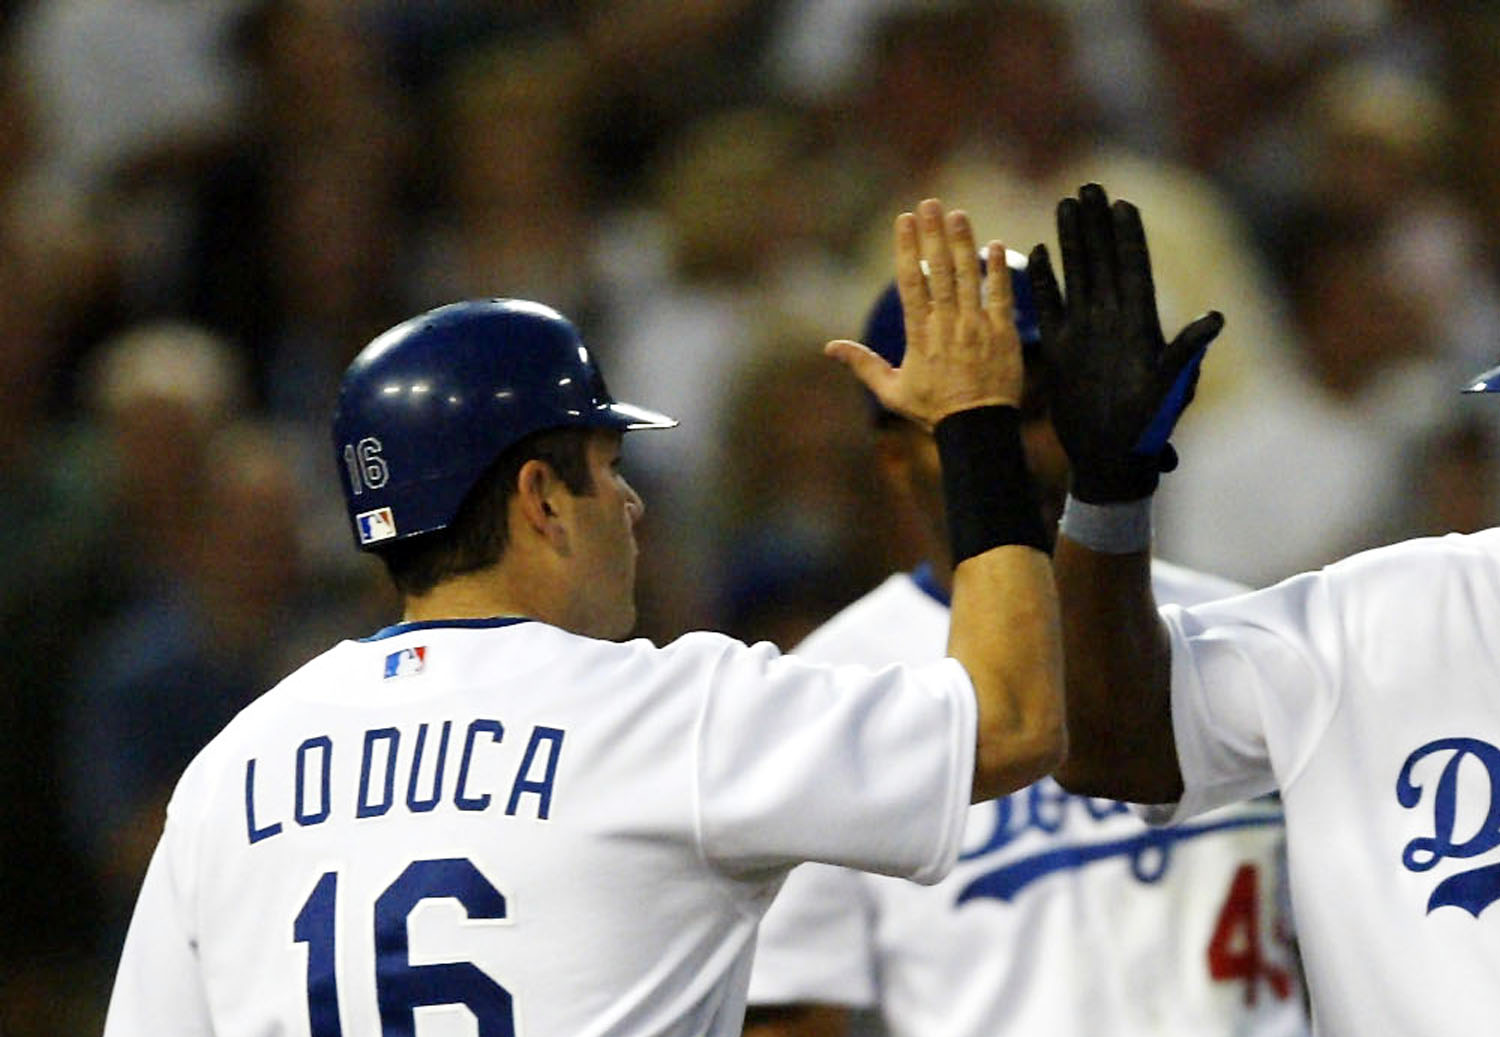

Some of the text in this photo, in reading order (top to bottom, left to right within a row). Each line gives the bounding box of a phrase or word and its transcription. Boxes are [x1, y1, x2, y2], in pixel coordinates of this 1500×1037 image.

[343, 437, 390, 495] 16
[244, 718, 565, 845] LO DUCA
[1207, 861, 1296, 1010] 4
